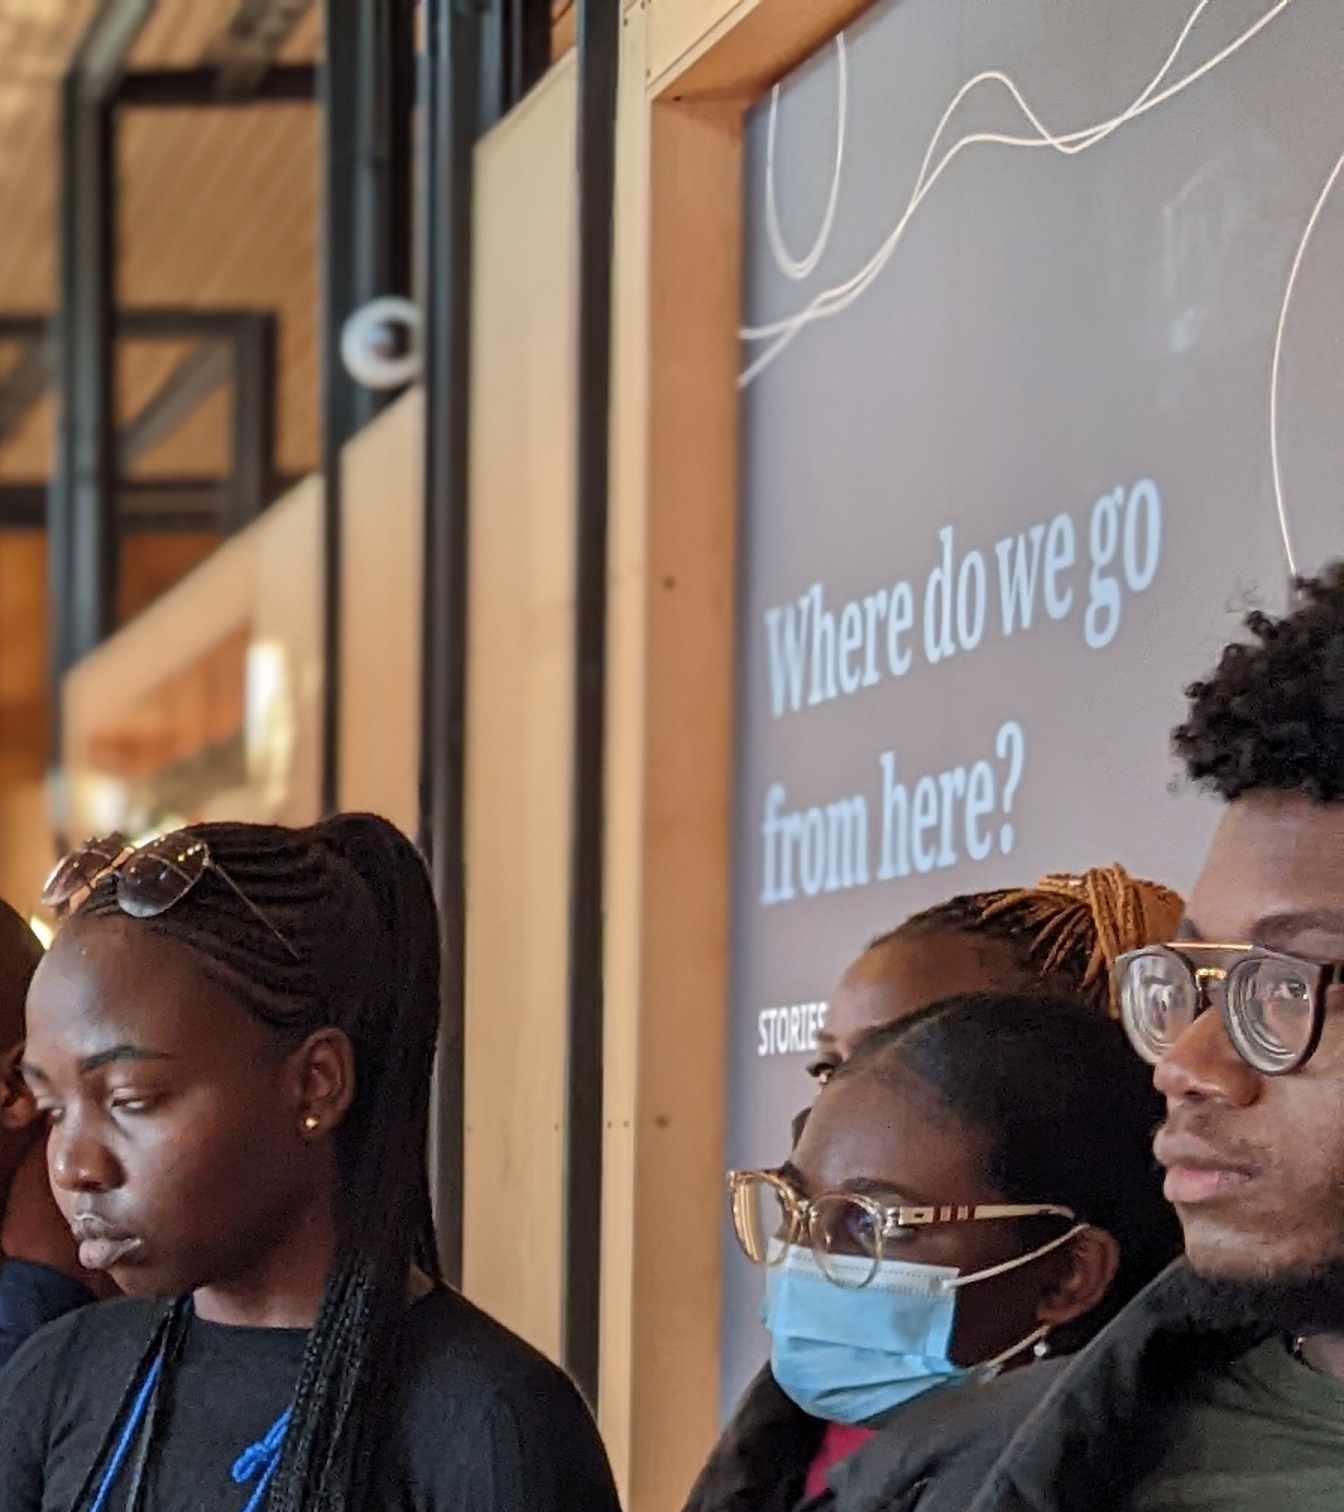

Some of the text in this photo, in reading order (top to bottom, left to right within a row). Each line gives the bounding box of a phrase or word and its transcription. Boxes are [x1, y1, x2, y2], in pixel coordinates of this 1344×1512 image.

[763, 477, 1162, 719] Where do we go
[760, 720, 1026, 907] from here?
